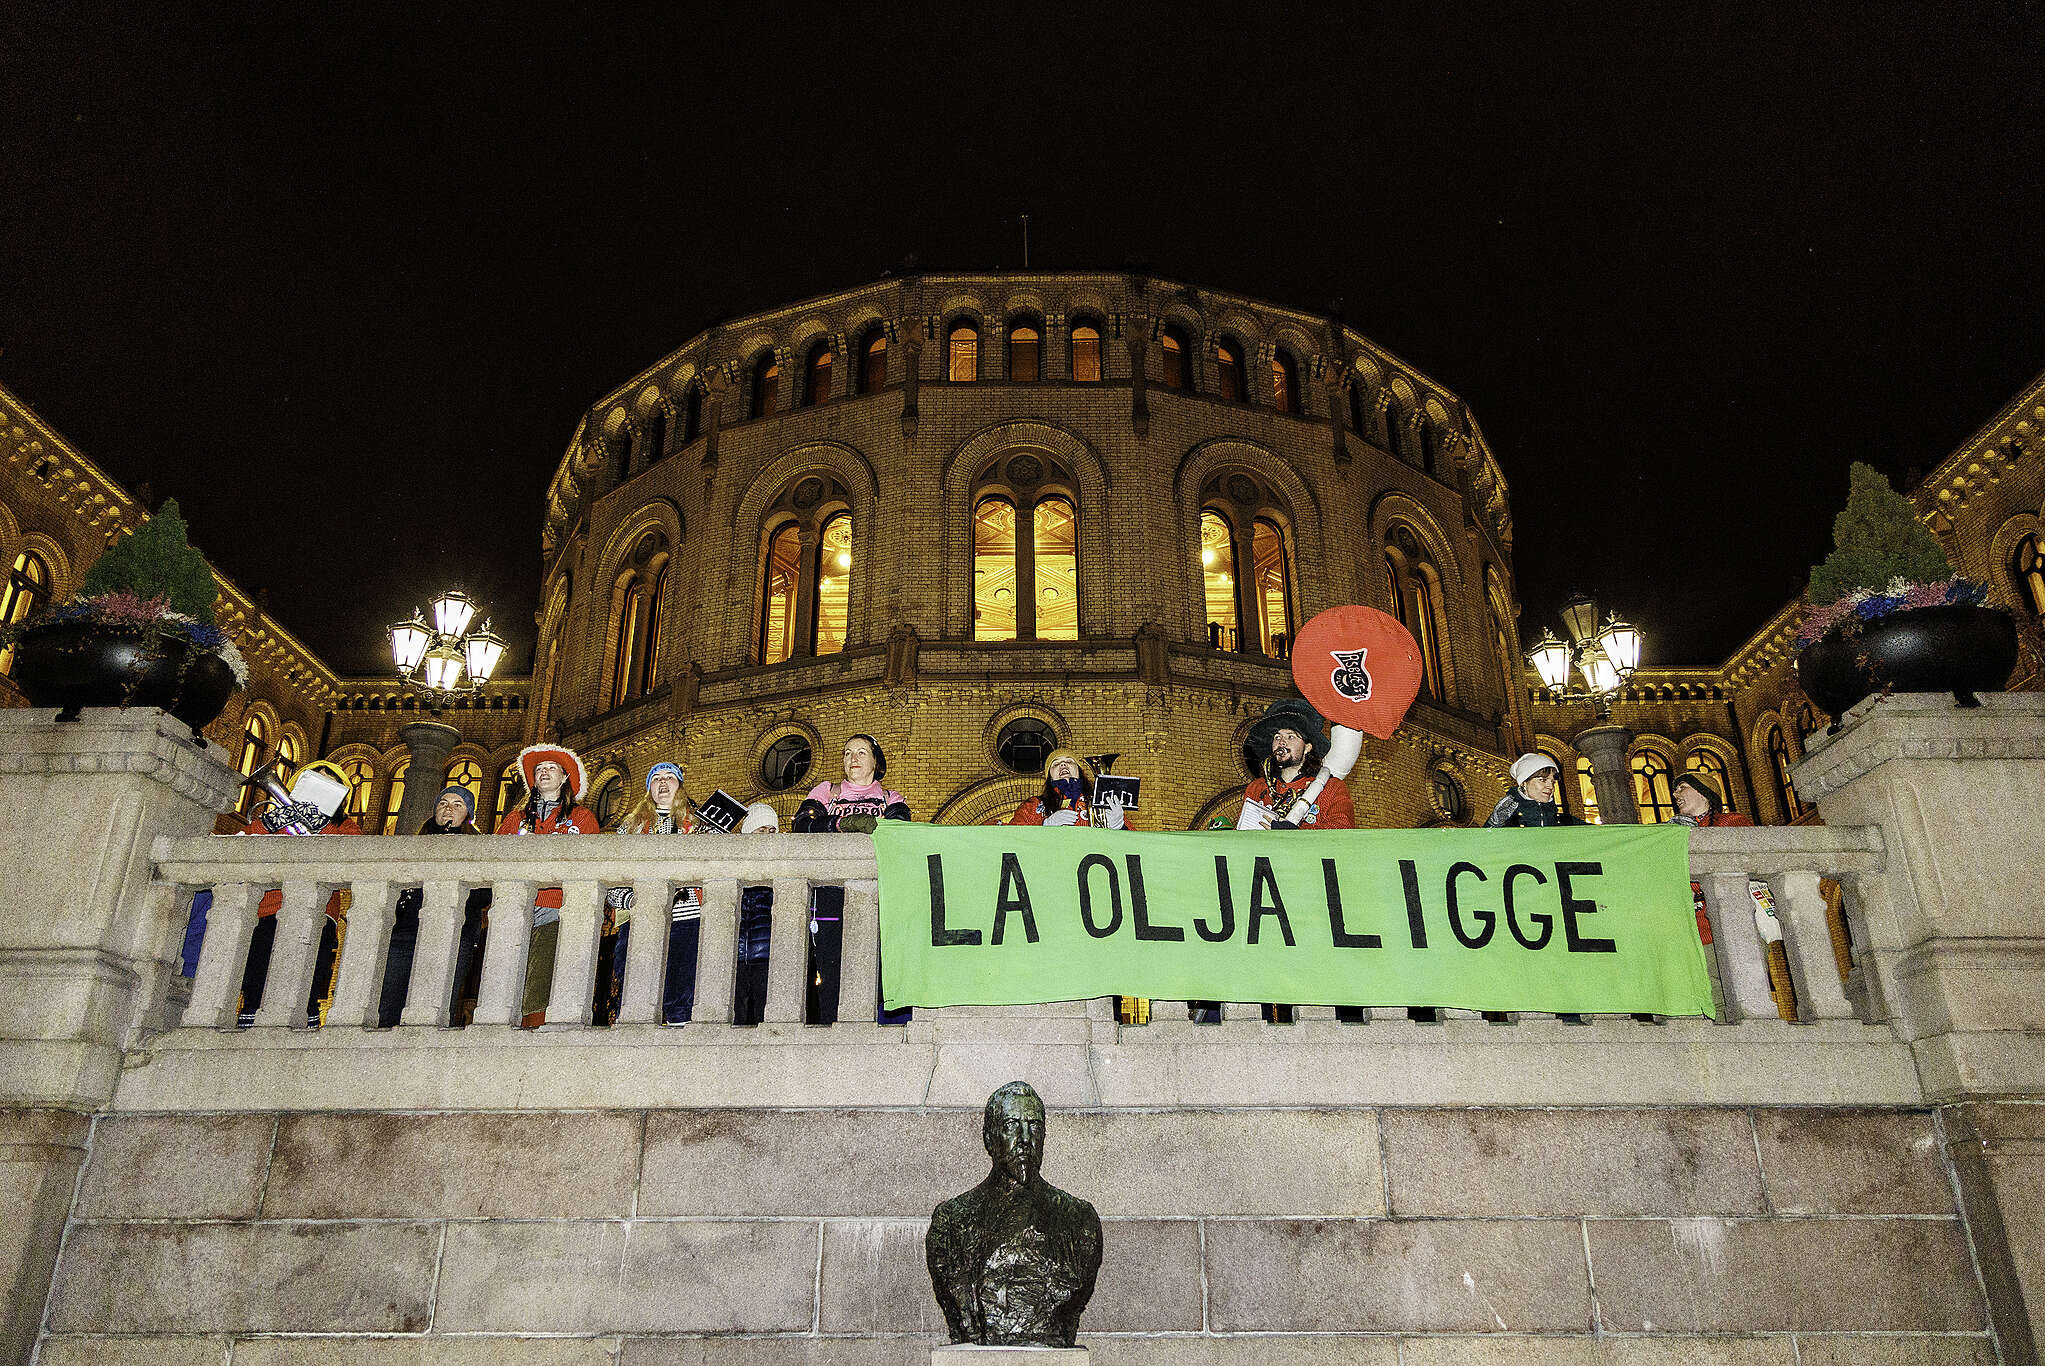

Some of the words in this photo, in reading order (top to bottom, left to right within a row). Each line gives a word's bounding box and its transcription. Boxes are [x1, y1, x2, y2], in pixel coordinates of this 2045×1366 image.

[927, 853, 1039, 946] LA
[1077, 854, 1296, 946] OLJA
[1322, 859, 1617, 953] LIGGE
